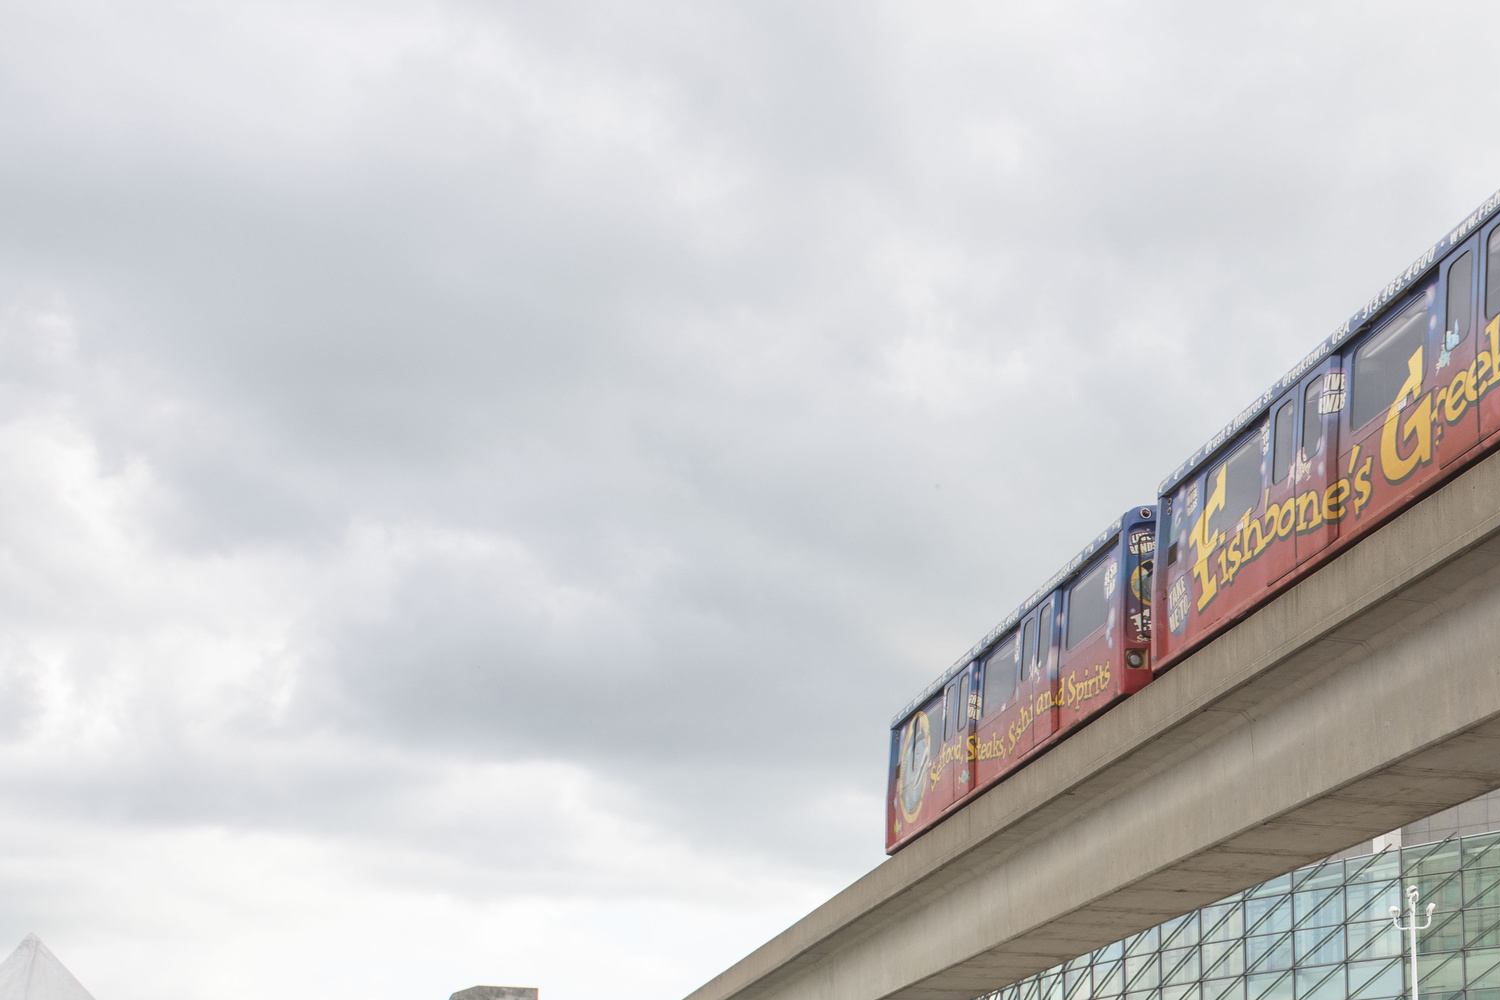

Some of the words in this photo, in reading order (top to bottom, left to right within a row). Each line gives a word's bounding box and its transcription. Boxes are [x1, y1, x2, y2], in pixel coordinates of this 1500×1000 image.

[1331, 324, 1351, 345] USA
[1189, 443, 1374, 613] Fishbone's
[1067, 661, 1112, 711] Spirits
